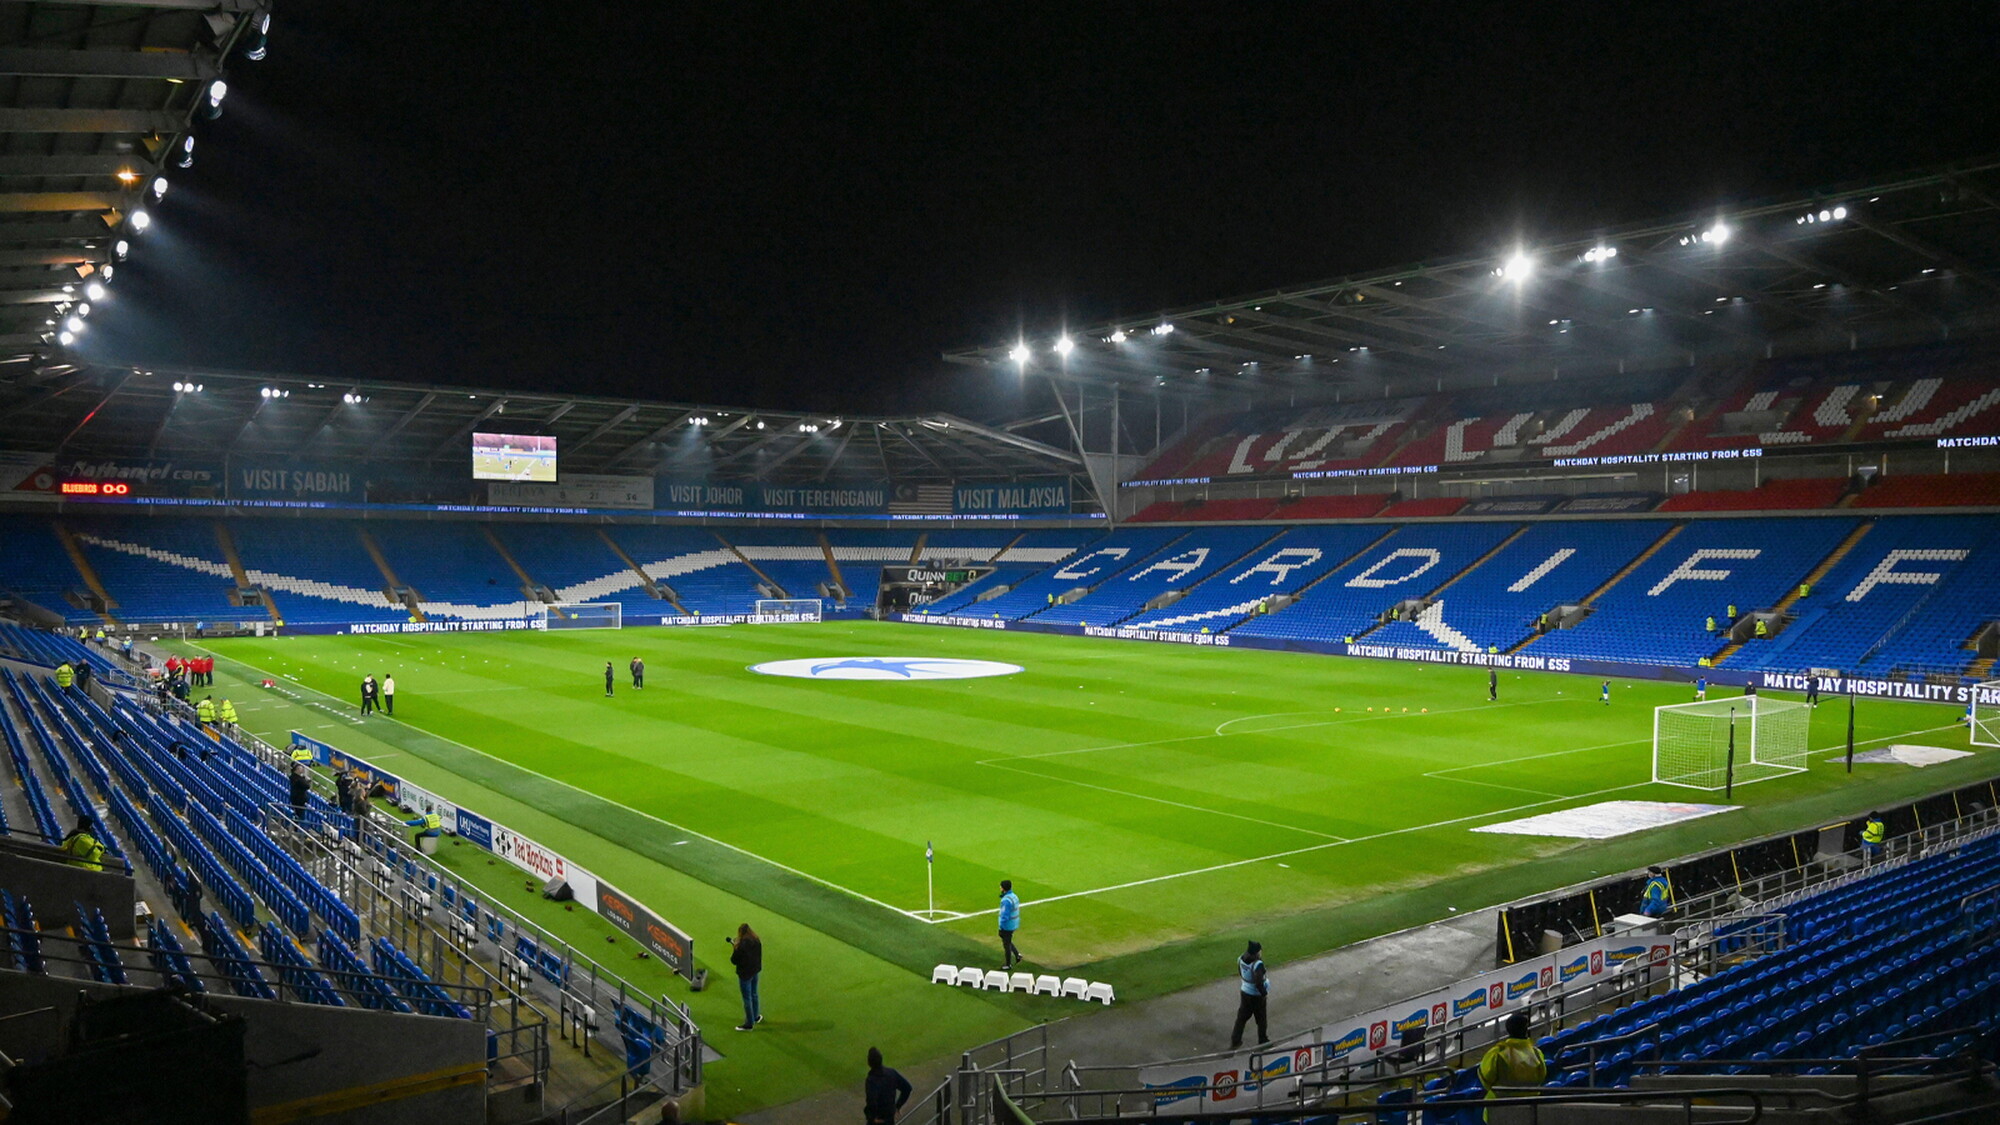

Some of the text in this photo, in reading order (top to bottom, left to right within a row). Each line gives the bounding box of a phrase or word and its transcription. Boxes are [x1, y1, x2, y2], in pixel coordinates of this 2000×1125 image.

[1553, 458, 1598, 467] MATCHDAY
[1600, 454, 1660, 465] HOSPITALITY
[1662, 451, 1709, 462] STARTING
[1712, 450, 1739, 459] FROM
[172, 469, 212, 481] cars
[1402, 466, 1422, 474] FROM
[62, 483, 128, 494] BLUEBIRDS 0-0
[243, 469, 351, 493] VISIT SABAH
[670, 485, 743, 505] VISIT JOHOR
[763, 488, 884, 507] VISIT TERENGGANU
[958, 486, 1066, 509] VISIT MALAYSIA
[351, 623, 400, 634] MATCHDAY
[402, 622, 460, 633] HOSPITALITY
[462, 621, 504, 631] STARTING
[661, 615, 700, 625] MATCHDAY
[781, 613, 800, 622] FROM
[980, 618, 994, 628] FROM
[1084, 626, 1116, 637] MATCHDAY
[1117, 628, 1158, 641] HOSPITALITY
[1159, 631, 1192, 643] STARTING
[1193, 633, 1213, 645] FROM
[1347, 644, 1395, 658] MATCHDAY
[1396, 648, 1459, 664] HOSPITALITY
[1461, 652, 1512, 667] STARTING
[1515, 656, 1545, 669] FROM
[1846, 679, 1953, 700] HOSPITALITY
[513, 836, 525, 862] Ted
[526, 843, 553, 877] Hopkins
